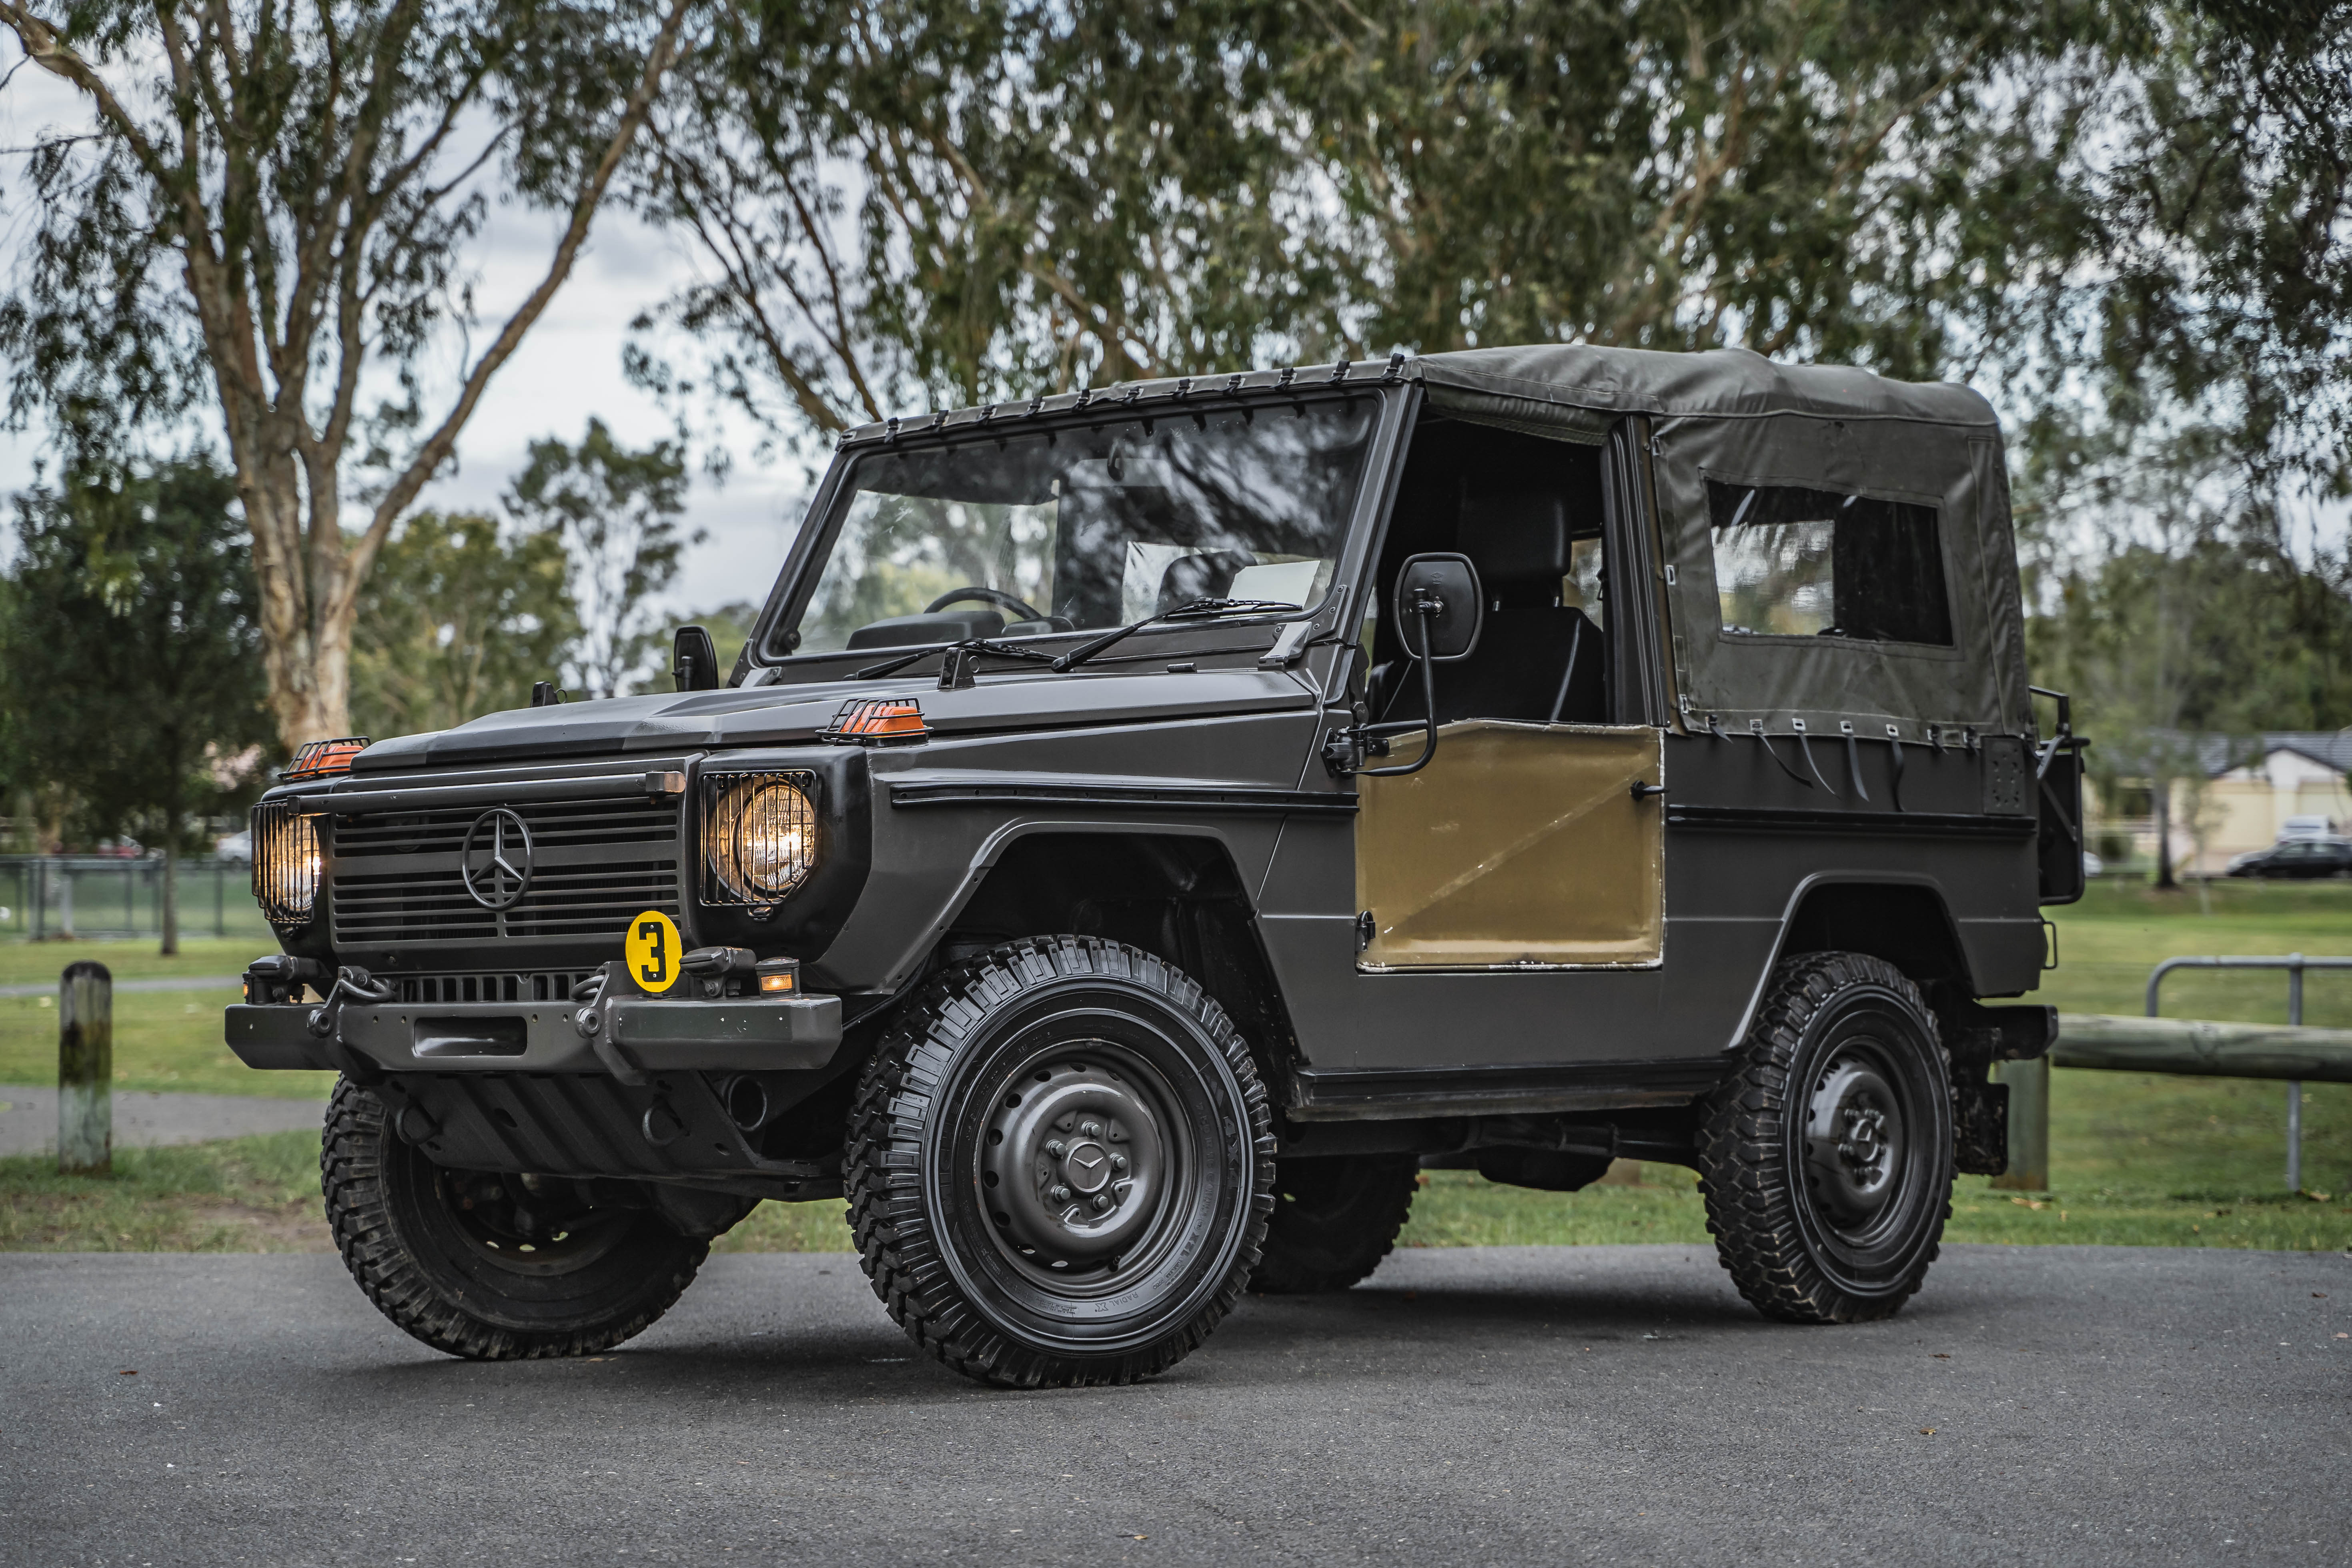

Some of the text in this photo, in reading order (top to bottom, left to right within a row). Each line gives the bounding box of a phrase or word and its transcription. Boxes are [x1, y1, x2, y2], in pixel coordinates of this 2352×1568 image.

[639, 921, 667, 982] 3
[1180, 1232, 1200, 1258] XZL
[1111, 1292, 1139, 1307] RADIAL
